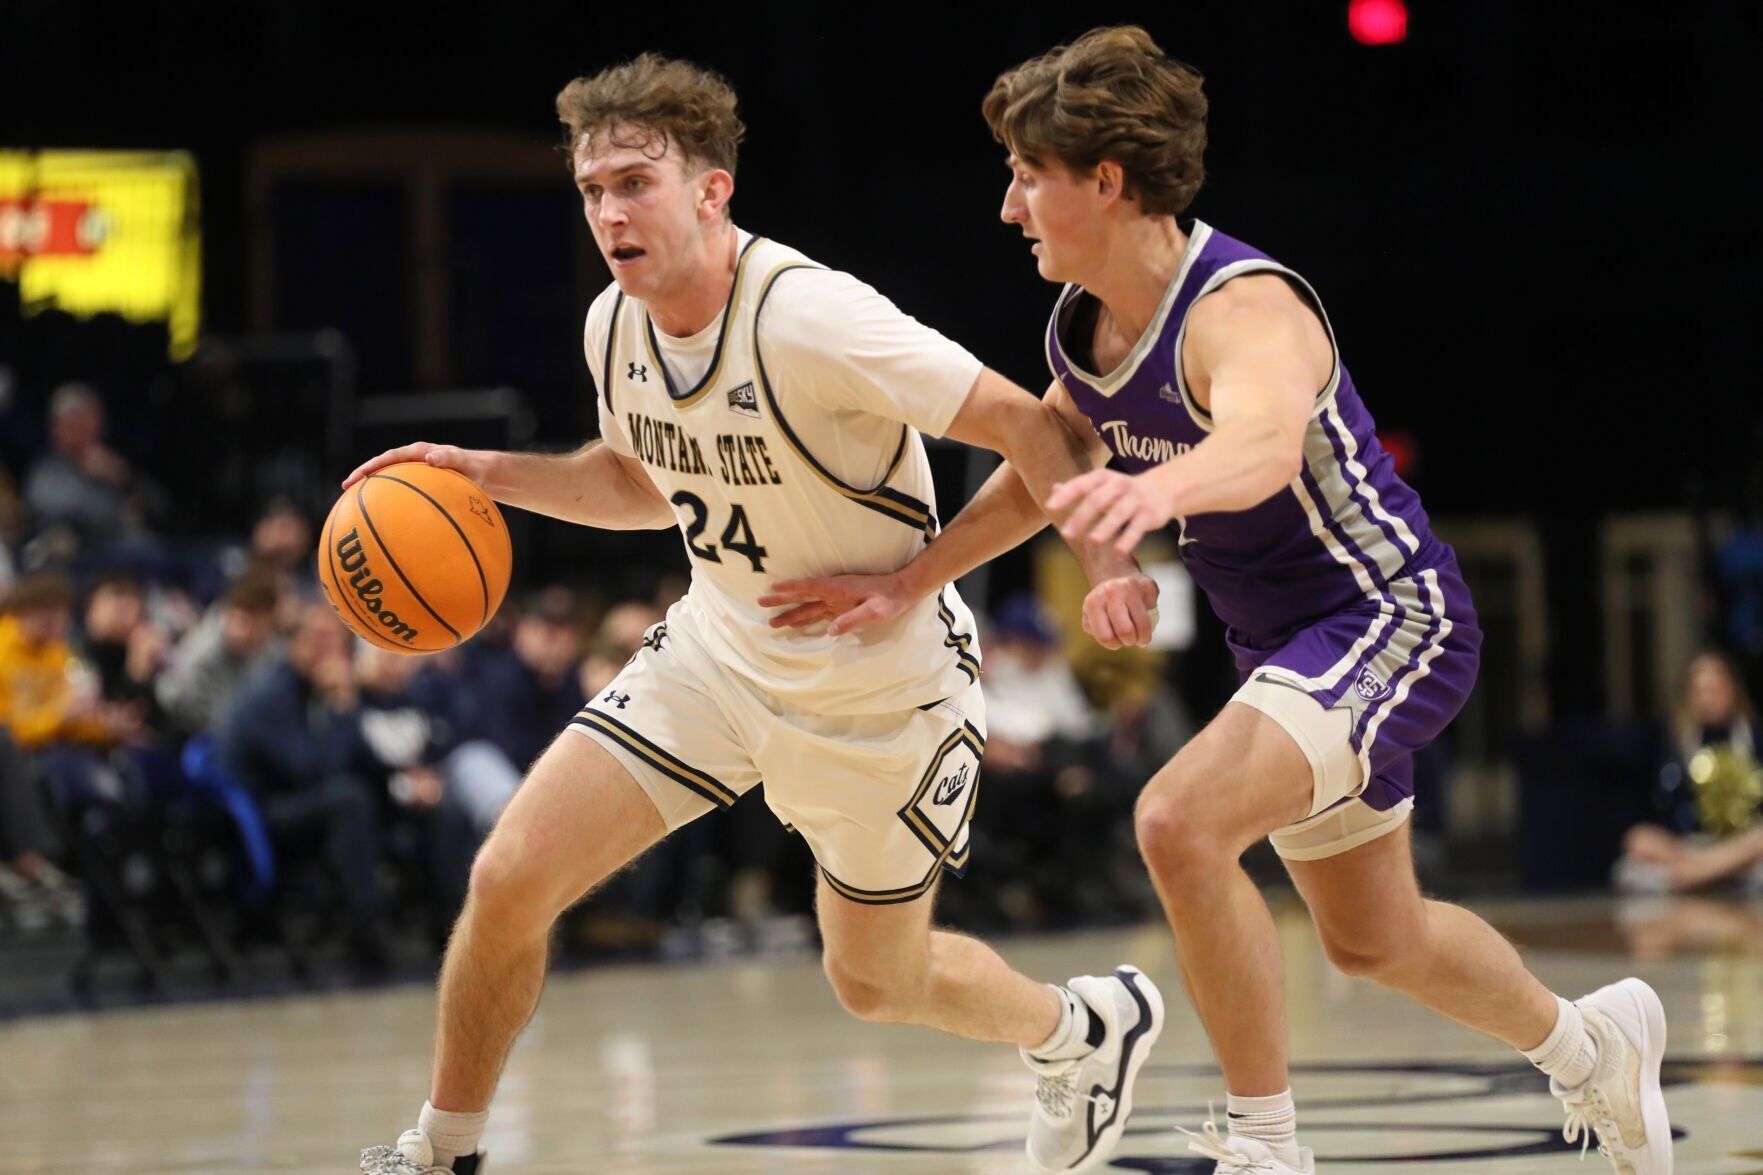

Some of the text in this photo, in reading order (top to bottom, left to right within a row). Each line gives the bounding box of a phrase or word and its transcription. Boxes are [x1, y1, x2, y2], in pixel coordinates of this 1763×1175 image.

[628, 412, 782, 486] MONTAN STATE
[671, 490, 769, 573] 24
[336, 526, 418, 643] Wilson
[932, 762, 970, 806] Cats
